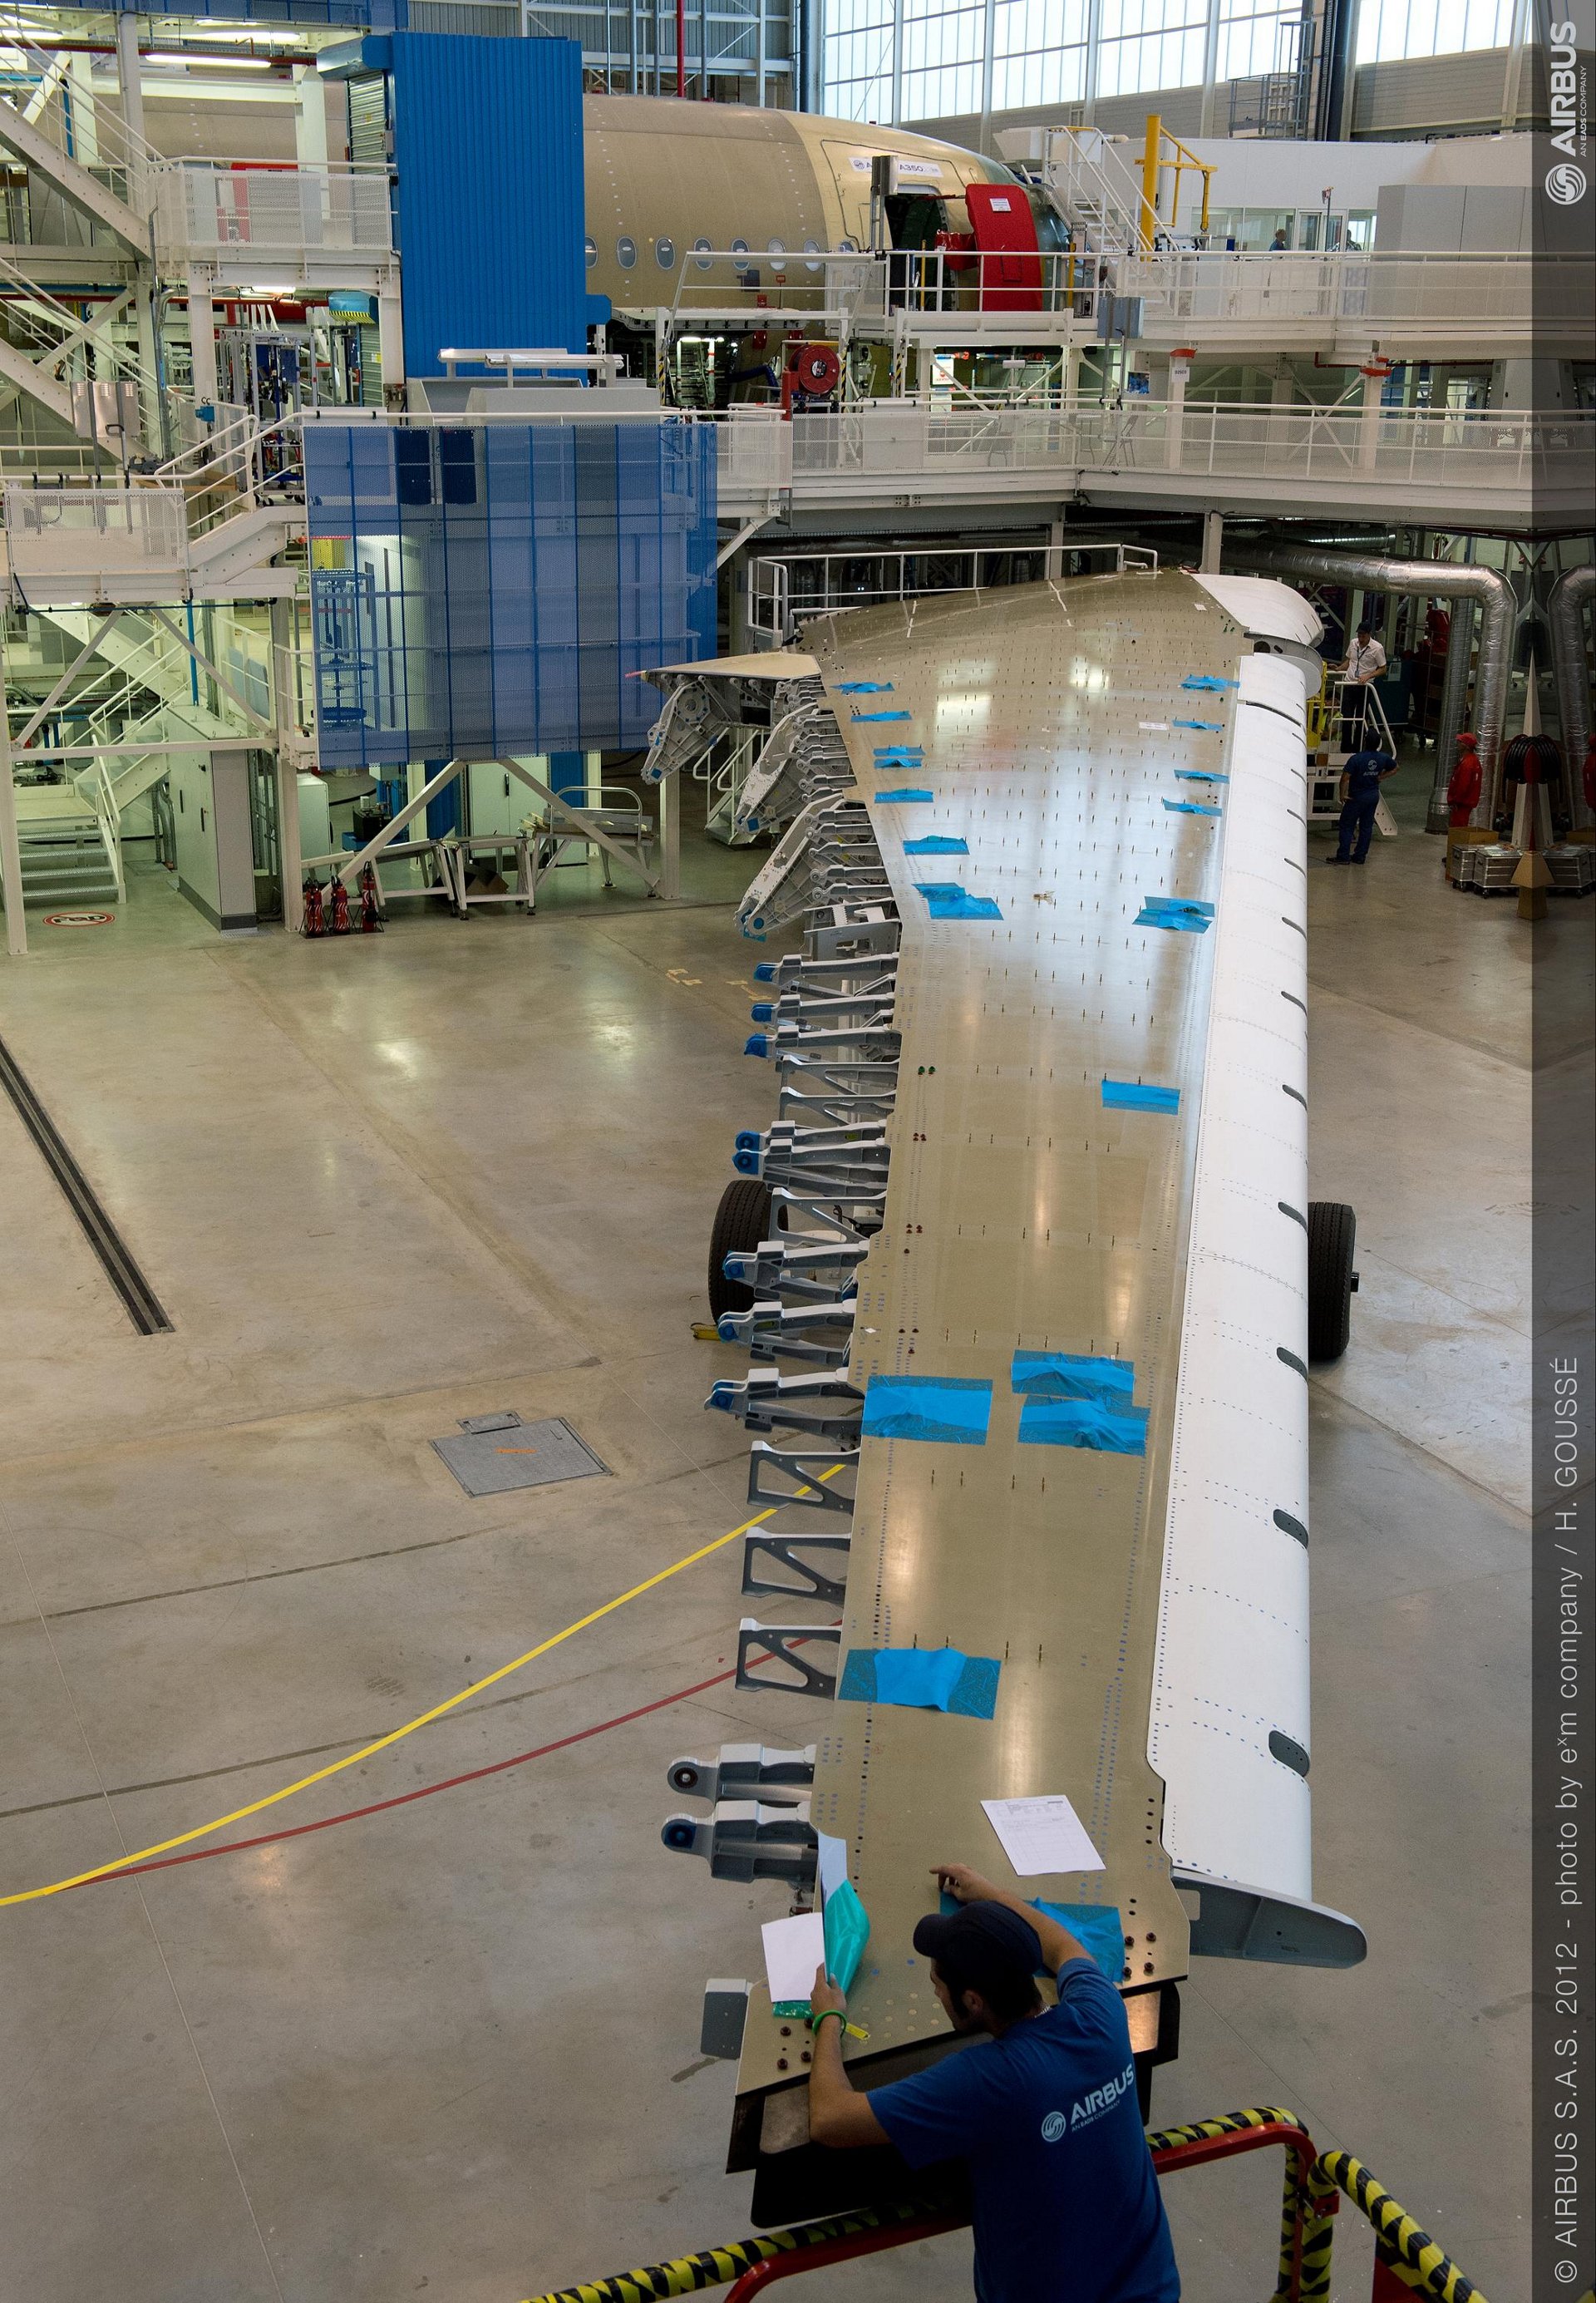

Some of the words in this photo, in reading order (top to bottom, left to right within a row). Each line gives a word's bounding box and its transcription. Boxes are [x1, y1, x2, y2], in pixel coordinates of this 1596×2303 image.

[1071, 2063, 1134, 2125] AIRBUS
[1080, 2116, 1095, 2128] EADS
[1094, 2098, 1121, 2120] COMPANY
